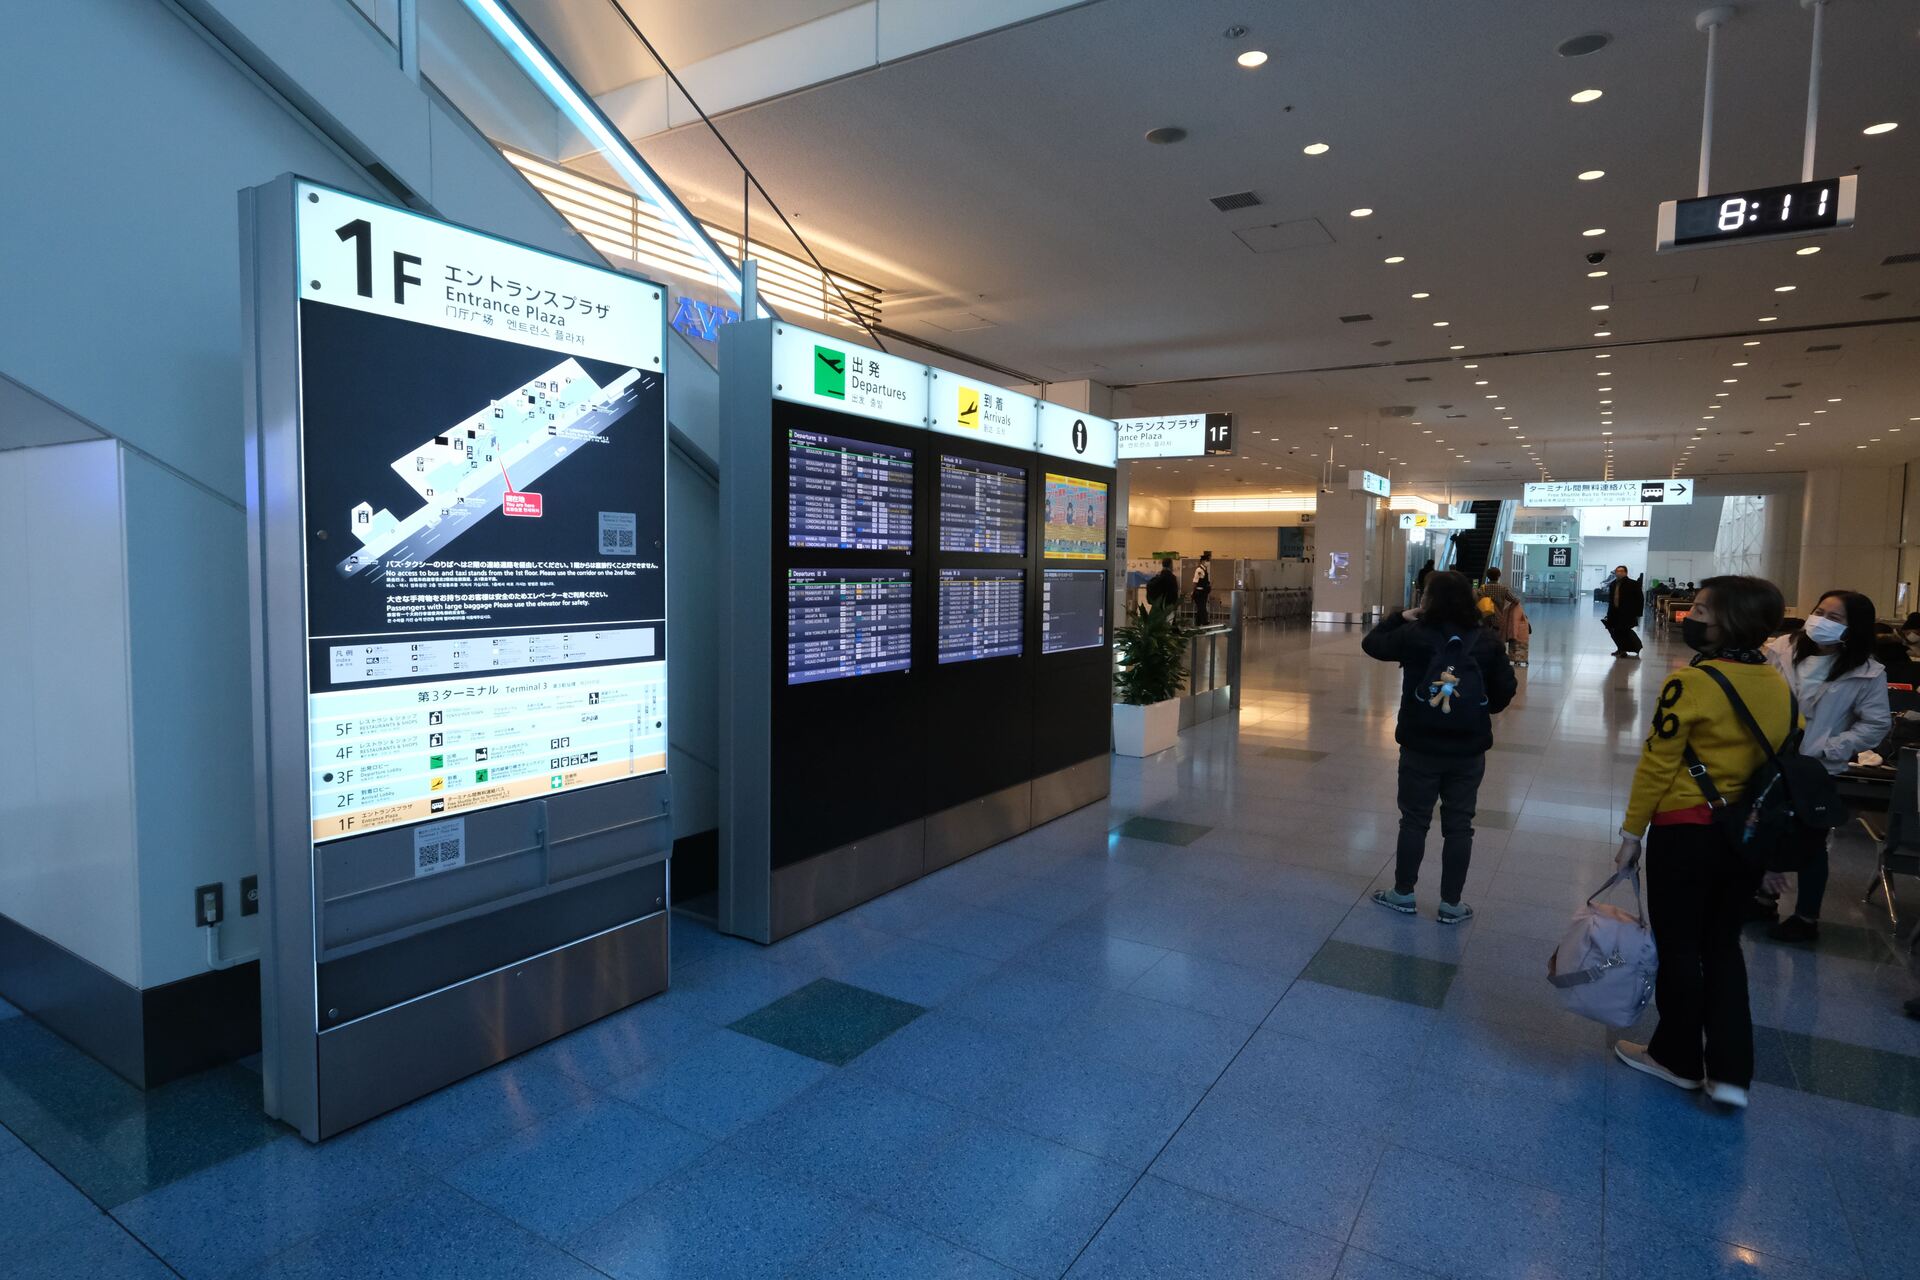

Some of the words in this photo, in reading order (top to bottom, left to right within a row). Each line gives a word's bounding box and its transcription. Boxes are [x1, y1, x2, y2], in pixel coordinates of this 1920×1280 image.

[1718, 188, 1828, 231] 8:11
[335, 218, 422, 305] 1F
[445, 265, 610, 319] エントランスプラザ
[446, 286, 520, 316] Entrance
[527, 305, 566, 327] Plaza
[446, 304, 494, 326] 门厅广场
[506, 319, 550, 338] 엔트런스
[554, 329, 585, 346] 플라자
[852, 356, 880, 378] 出発
[851, 375, 907, 401] Departures
[984, 393, 1003, 411] 到着
[984, 410, 1011, 426] Arrivals
[1209, 426, 1228, 442] 1F
[387, 604, 426, 612] Passengers
[444, 603, 462, 611] large
[464, 602, 492, 610] baggage
[506, 683, 540, 693] Terminal
[543, 682, 548, 690] 3
[336, 722, 352, 736] 5F
[336, 746, 353, 759] 4F
[337, 770, 353, 784] 3F
[337, 793, 354, 807] 2F
[362, 804, 413, 818] エントランスプラザ
[339, 816, 355, 830] 1F
